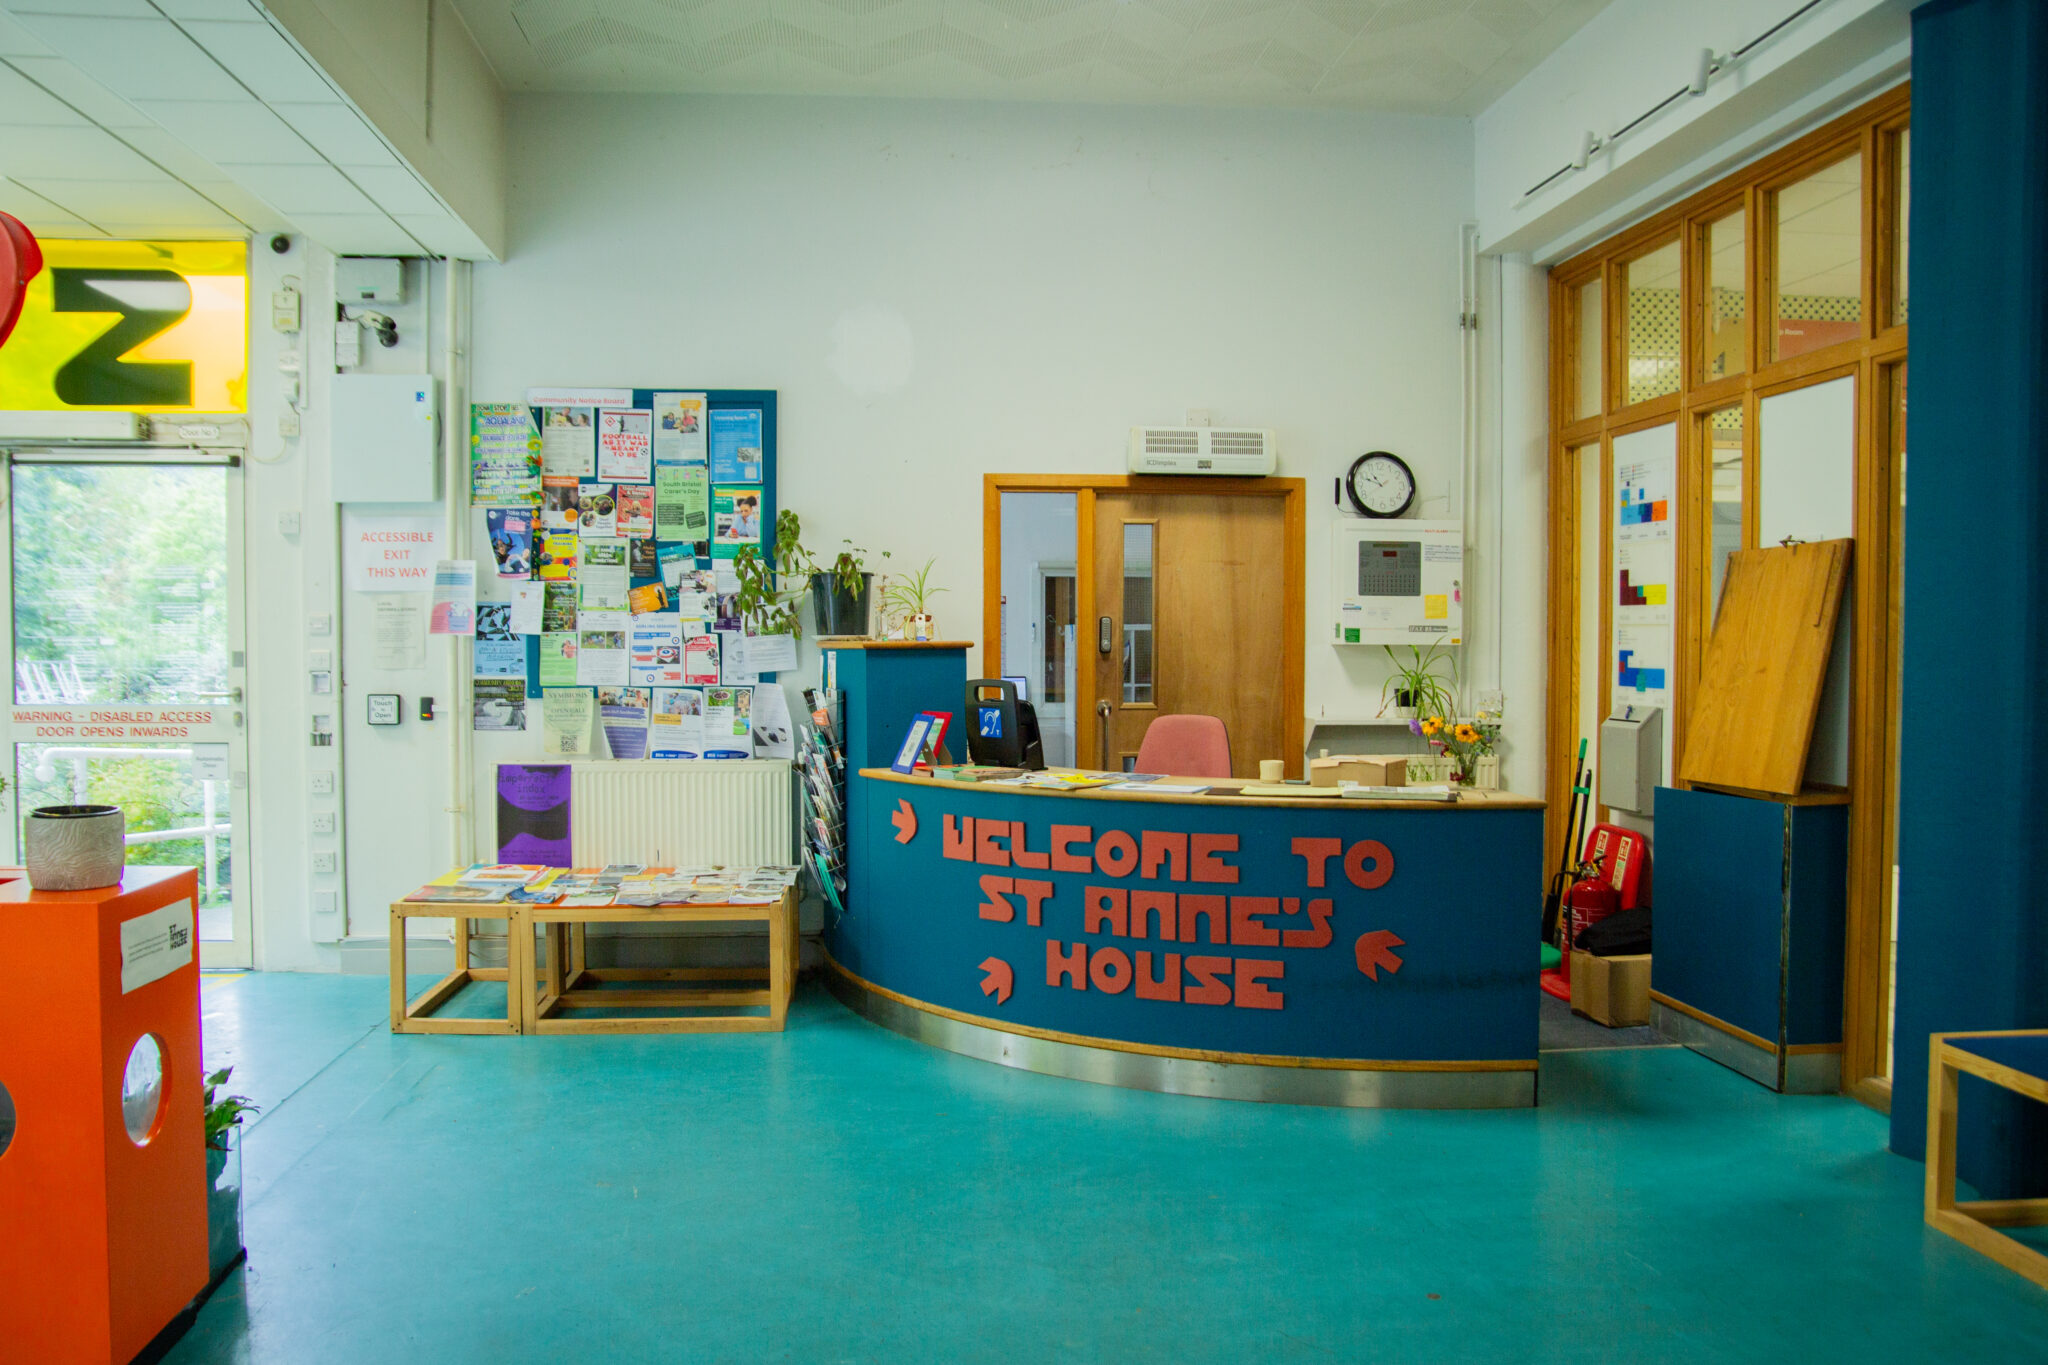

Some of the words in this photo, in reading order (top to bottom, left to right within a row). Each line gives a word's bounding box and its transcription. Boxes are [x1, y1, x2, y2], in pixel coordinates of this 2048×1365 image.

[533, 397, 576, 405] Community
[361, 532, 434, 542] ACCESSIBLE
[384, 550, 411, 560] EXIT
[368, 567, 396, 578] THIS
[398, 567, 428, 577] WAY
[12, 711, 72, 722] WARNING
[90, 711, 154, 722] DISABLED
[159, 711, 212, 722] ACCESS
[36, 726, 75, 737] DOOR
[80, 726, 124, 737] OPENS
[129, 726, 189, 737] INWARDS
[942, 812, 1240, 884] WELCOME
[1290, 836, 1395, 890] TO
[978, 874, 1054, 927] ST
[1084, 885, 1334, 949] ANNE'S
[1046, 938, 1284, 1010] HOUSE
